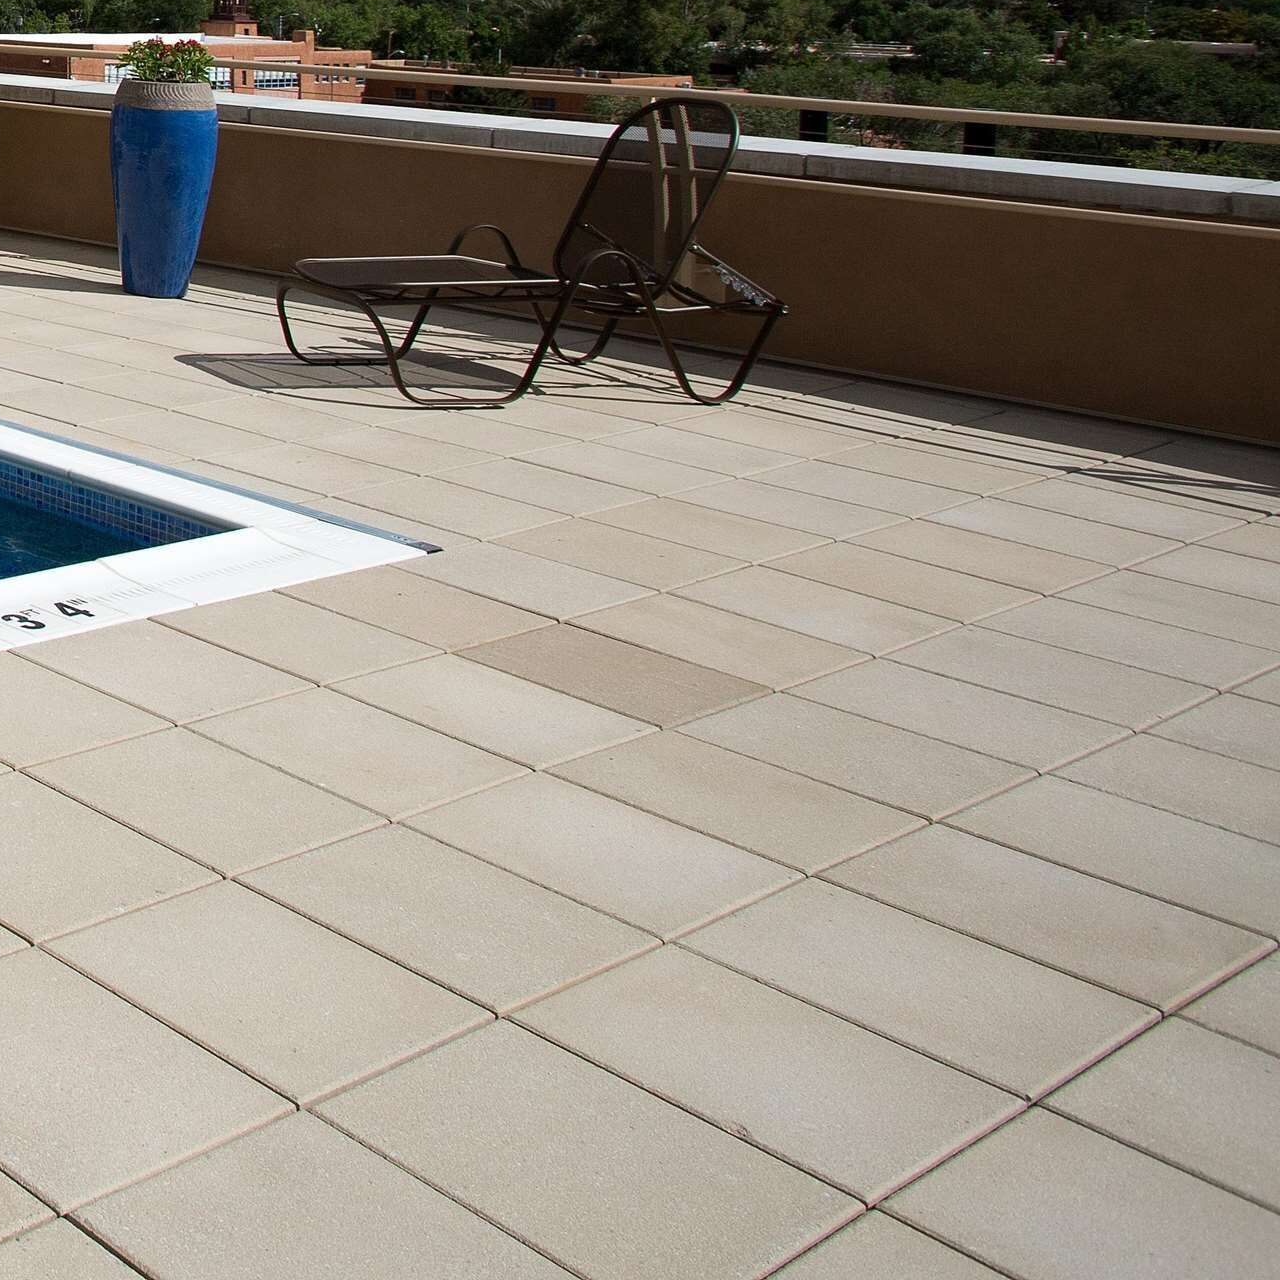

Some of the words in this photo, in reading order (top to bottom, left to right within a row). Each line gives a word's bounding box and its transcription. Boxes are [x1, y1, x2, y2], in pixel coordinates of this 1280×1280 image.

[20, 609, 40, 617] FT
[54, 602, 95, 617] 4
[1, 614, 46, 629] 3
